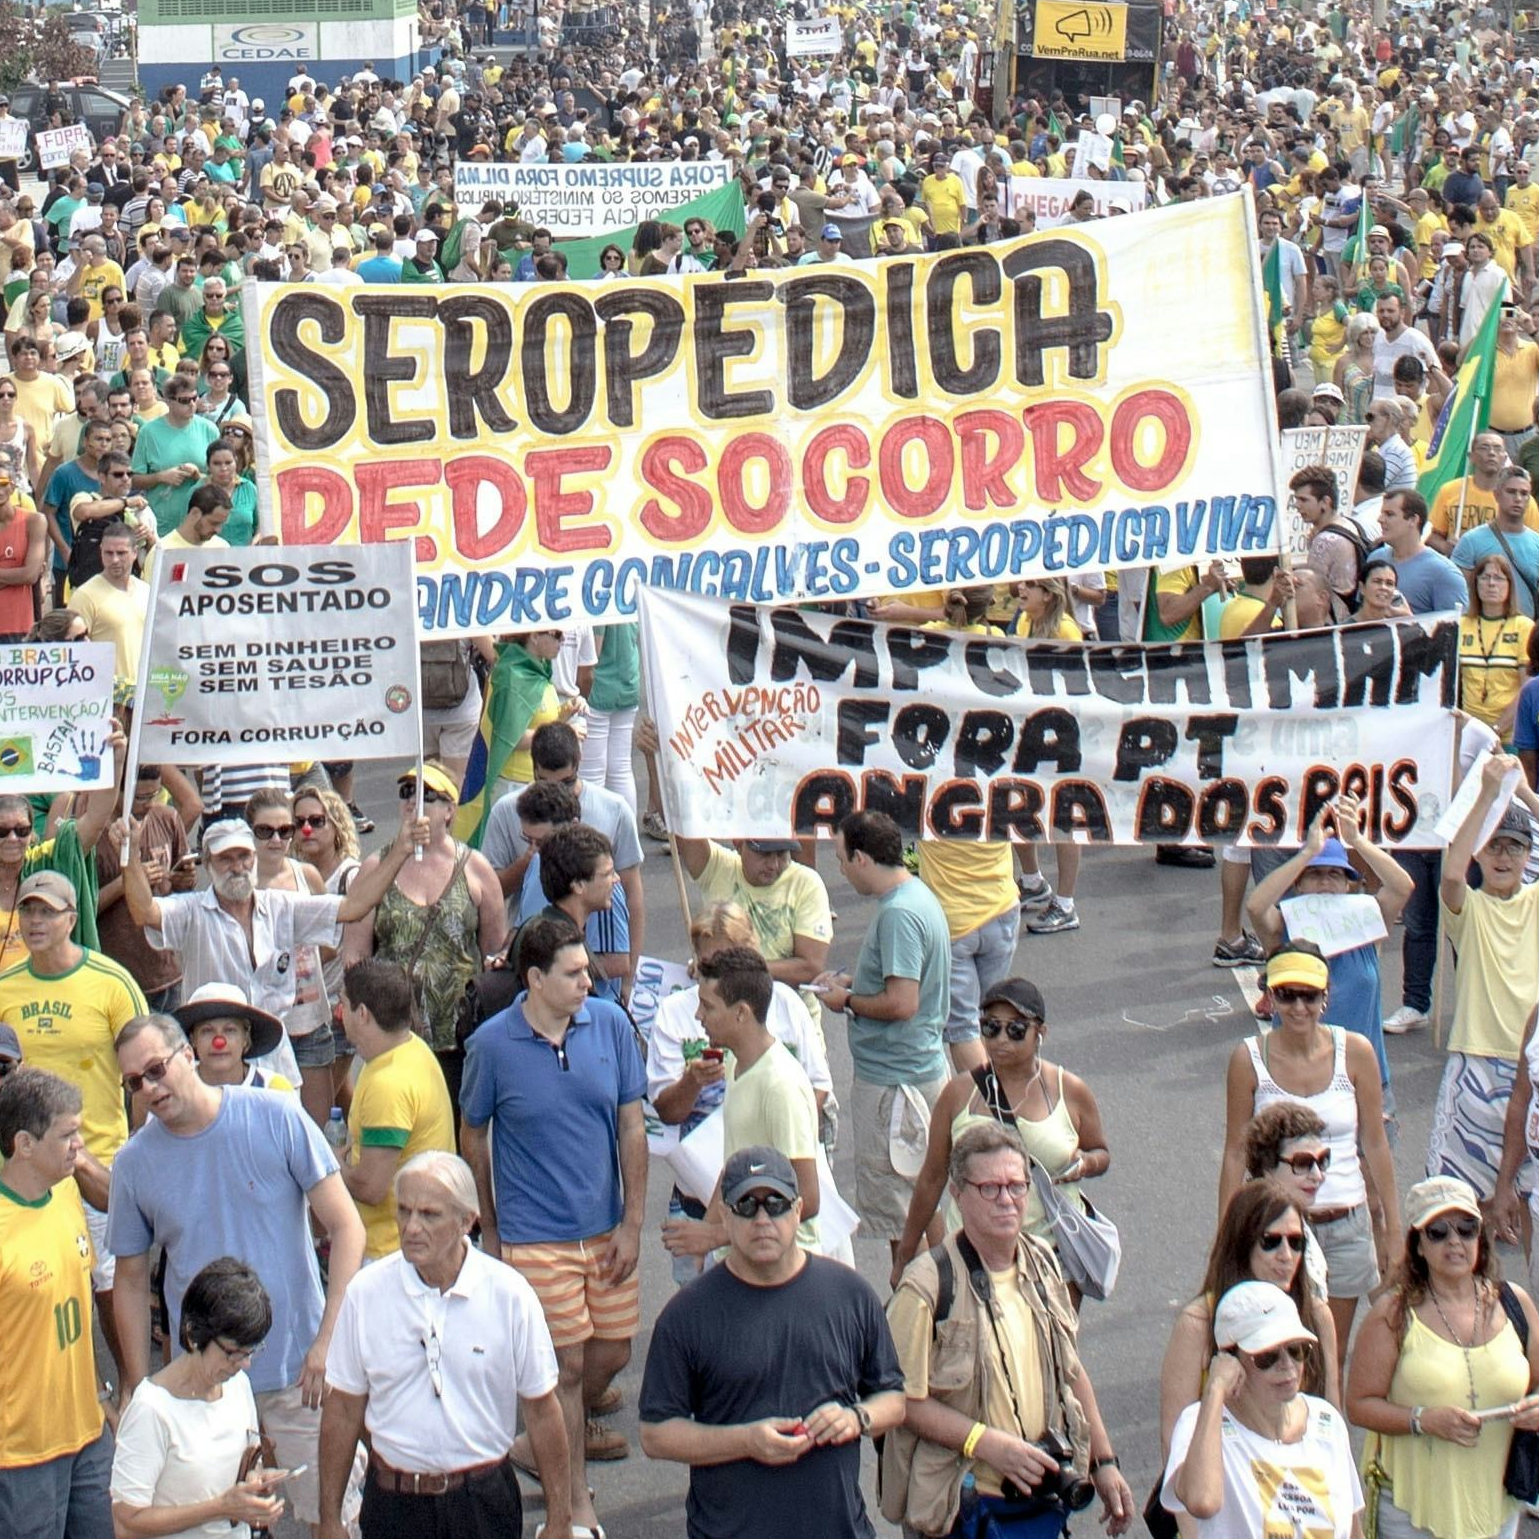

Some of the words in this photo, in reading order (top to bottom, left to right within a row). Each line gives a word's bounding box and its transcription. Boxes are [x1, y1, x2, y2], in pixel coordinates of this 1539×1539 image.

[222, 48, 310, 59] CEDAE
[1037, 44, 1119, 59] VemPraRua.net
[43, 128, 85, 148] FORA
[272, 239, 1113, 451] SEROPÉDICA
[641, 388, 1192, 542] SOCORRO
[887, 503, 1171, 594] SEROPÉDICA
[1175, 493, 1278, 555] VIVA
[201, 561, 357, 589] SOS
[177, 587, 392, 618] APOSENTADO
[10, 648, 80, 666] BRASIL
[178, 643, 237, 660] SEM
[246, 635, 397, 658] DINHEIRO
[199, 659, 258, 677] SEM
[267, 653, 373, 674] SAUDE
[198, 677, 259, 694] SEM
[268, 669, 373, 691] TESÃO
[170, 729, 233, 745] FORA
[239, 718, 386, 743] CORRUPÇÃO
[835, 699, 1082, 777] FORA
[1112, 713, 1239, 781] PT
[791, 768, 1114, 844] ANGRA
[1134, 774, 1291, 846] DOS
[20, 1000, 73, 1021] BRASIL
[53, 1296, 82, 1352] 10
